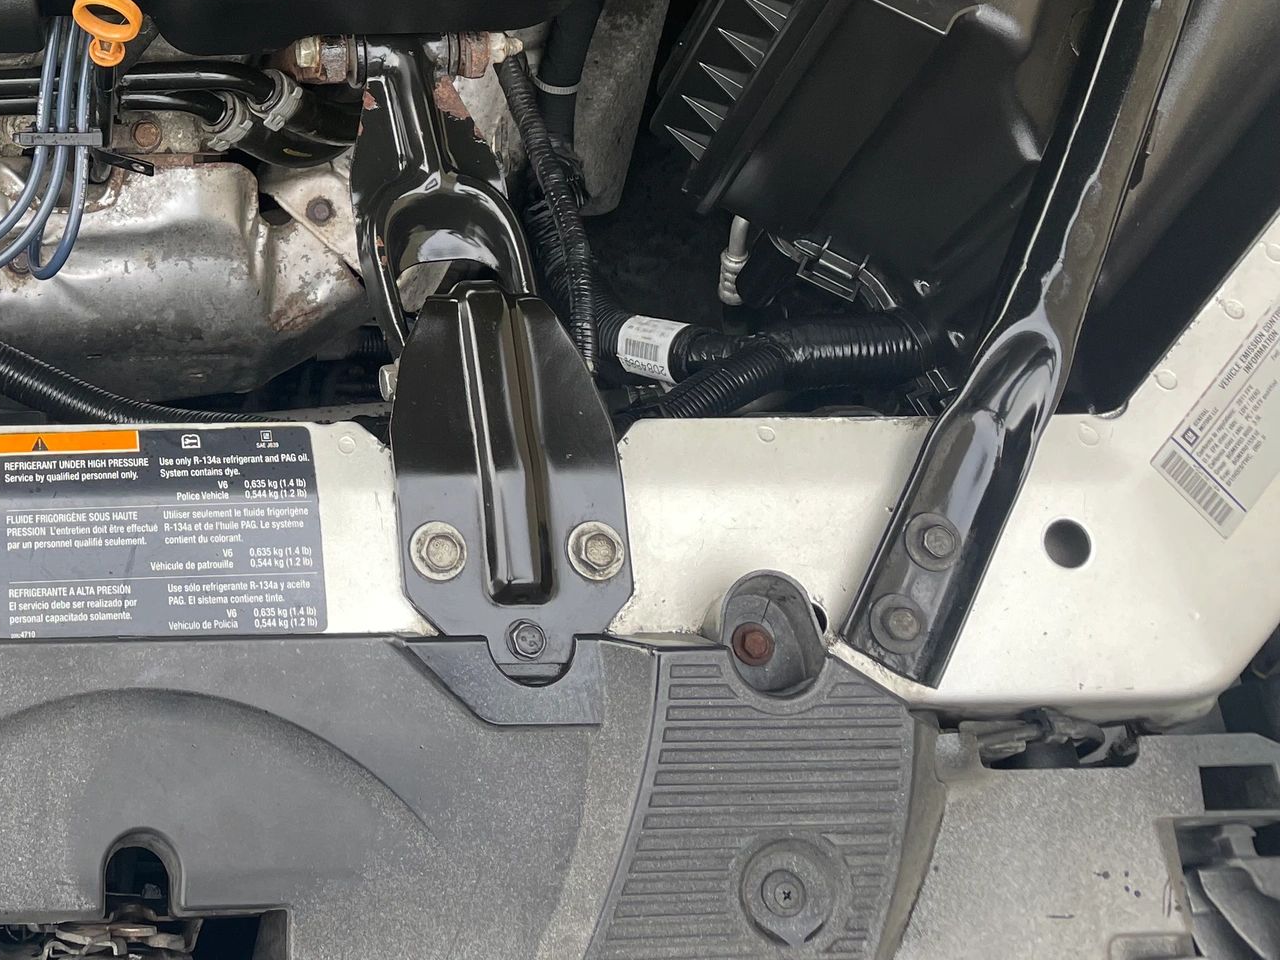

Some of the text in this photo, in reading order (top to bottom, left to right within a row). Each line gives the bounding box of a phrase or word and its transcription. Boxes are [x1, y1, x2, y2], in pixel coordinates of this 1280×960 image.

[1243, 329, 1279, 374] INFORMATION
[1218, 361, 1242, 390] VEHICLE
[1238, 331, 1266, 364] EMISSION
[4, 457, 149, 471] REFRIGERANT UNDER HIGH PRESSURE
[159, 453, 310, 467] Use only R-134a refrigerant and PAG oil.
[4, 470, 139, 484] Service by qualified personnel only.
[160, 466, 241, 479] System contains dye.
[217, 480, 229, 490] V6
[267, 479, 278, 490] kg
[279, 478, 295, 490] (1.4
[295, 478, 307, 488] lb)
[176, 491, 200, 502] Police
[201, 491, 230, 501] Vehicle
[268, 489, 279, 500] kg
[296, 488, 308, 498] lb)
[6, 511, 138, 524] FLUIDE FRIGORIGÈNE SOUS HAUTE
[163, 506, 309, 520] Utiliser seulement le fluide frigorigène
[50, 525, 91, 536] L'entretien
[92, 524, 108, 534] doit
[109, 523, 125, 534] être
[126, 523, 158, 533] effectué
[164, 519, 304, 532] R-134a et de l'huile PAG. Le système
[7, 536, 147, 551] par un personnel qualifié seulement.
[164, 533, 244, 545] contient du colorant.
[222, 548, 234, 558] V6
[273, 547, 284, 559] kg
[285, 546, 301, 558] (1.4
[301, 546, 312, 557] lb)
[150, 560, 184, 572] Véhicule
[185, 560, 196, 570] de
[197, 559, 234, 571] patrouille
[273, 557, 285, 569] kg
[302, 556, 313, 567] lb)
[8, 583, 132, 599] REFRIGERANTE A ALTA PRESIÓN
[167, 579, 311, 593] Use sólo refrigerante R-134a y aceite
[8, 598, 138, 611] El servicio debe ser realizado por
[168, 593, 285, 606] PAG. El sistema contiene tinte.
[9, 611, 133, 626] personal capacitado solamente.
[226, 608, 237, 618] V6
[277, 607, 288, 619] kg
[289, 606, 305, 617] (1.4
[306, 606, 317, 617] lb)
[202, 620, 212, 630] de
[277, 617, 289, 629] kg
[307, 616, 318, 627] lb)
